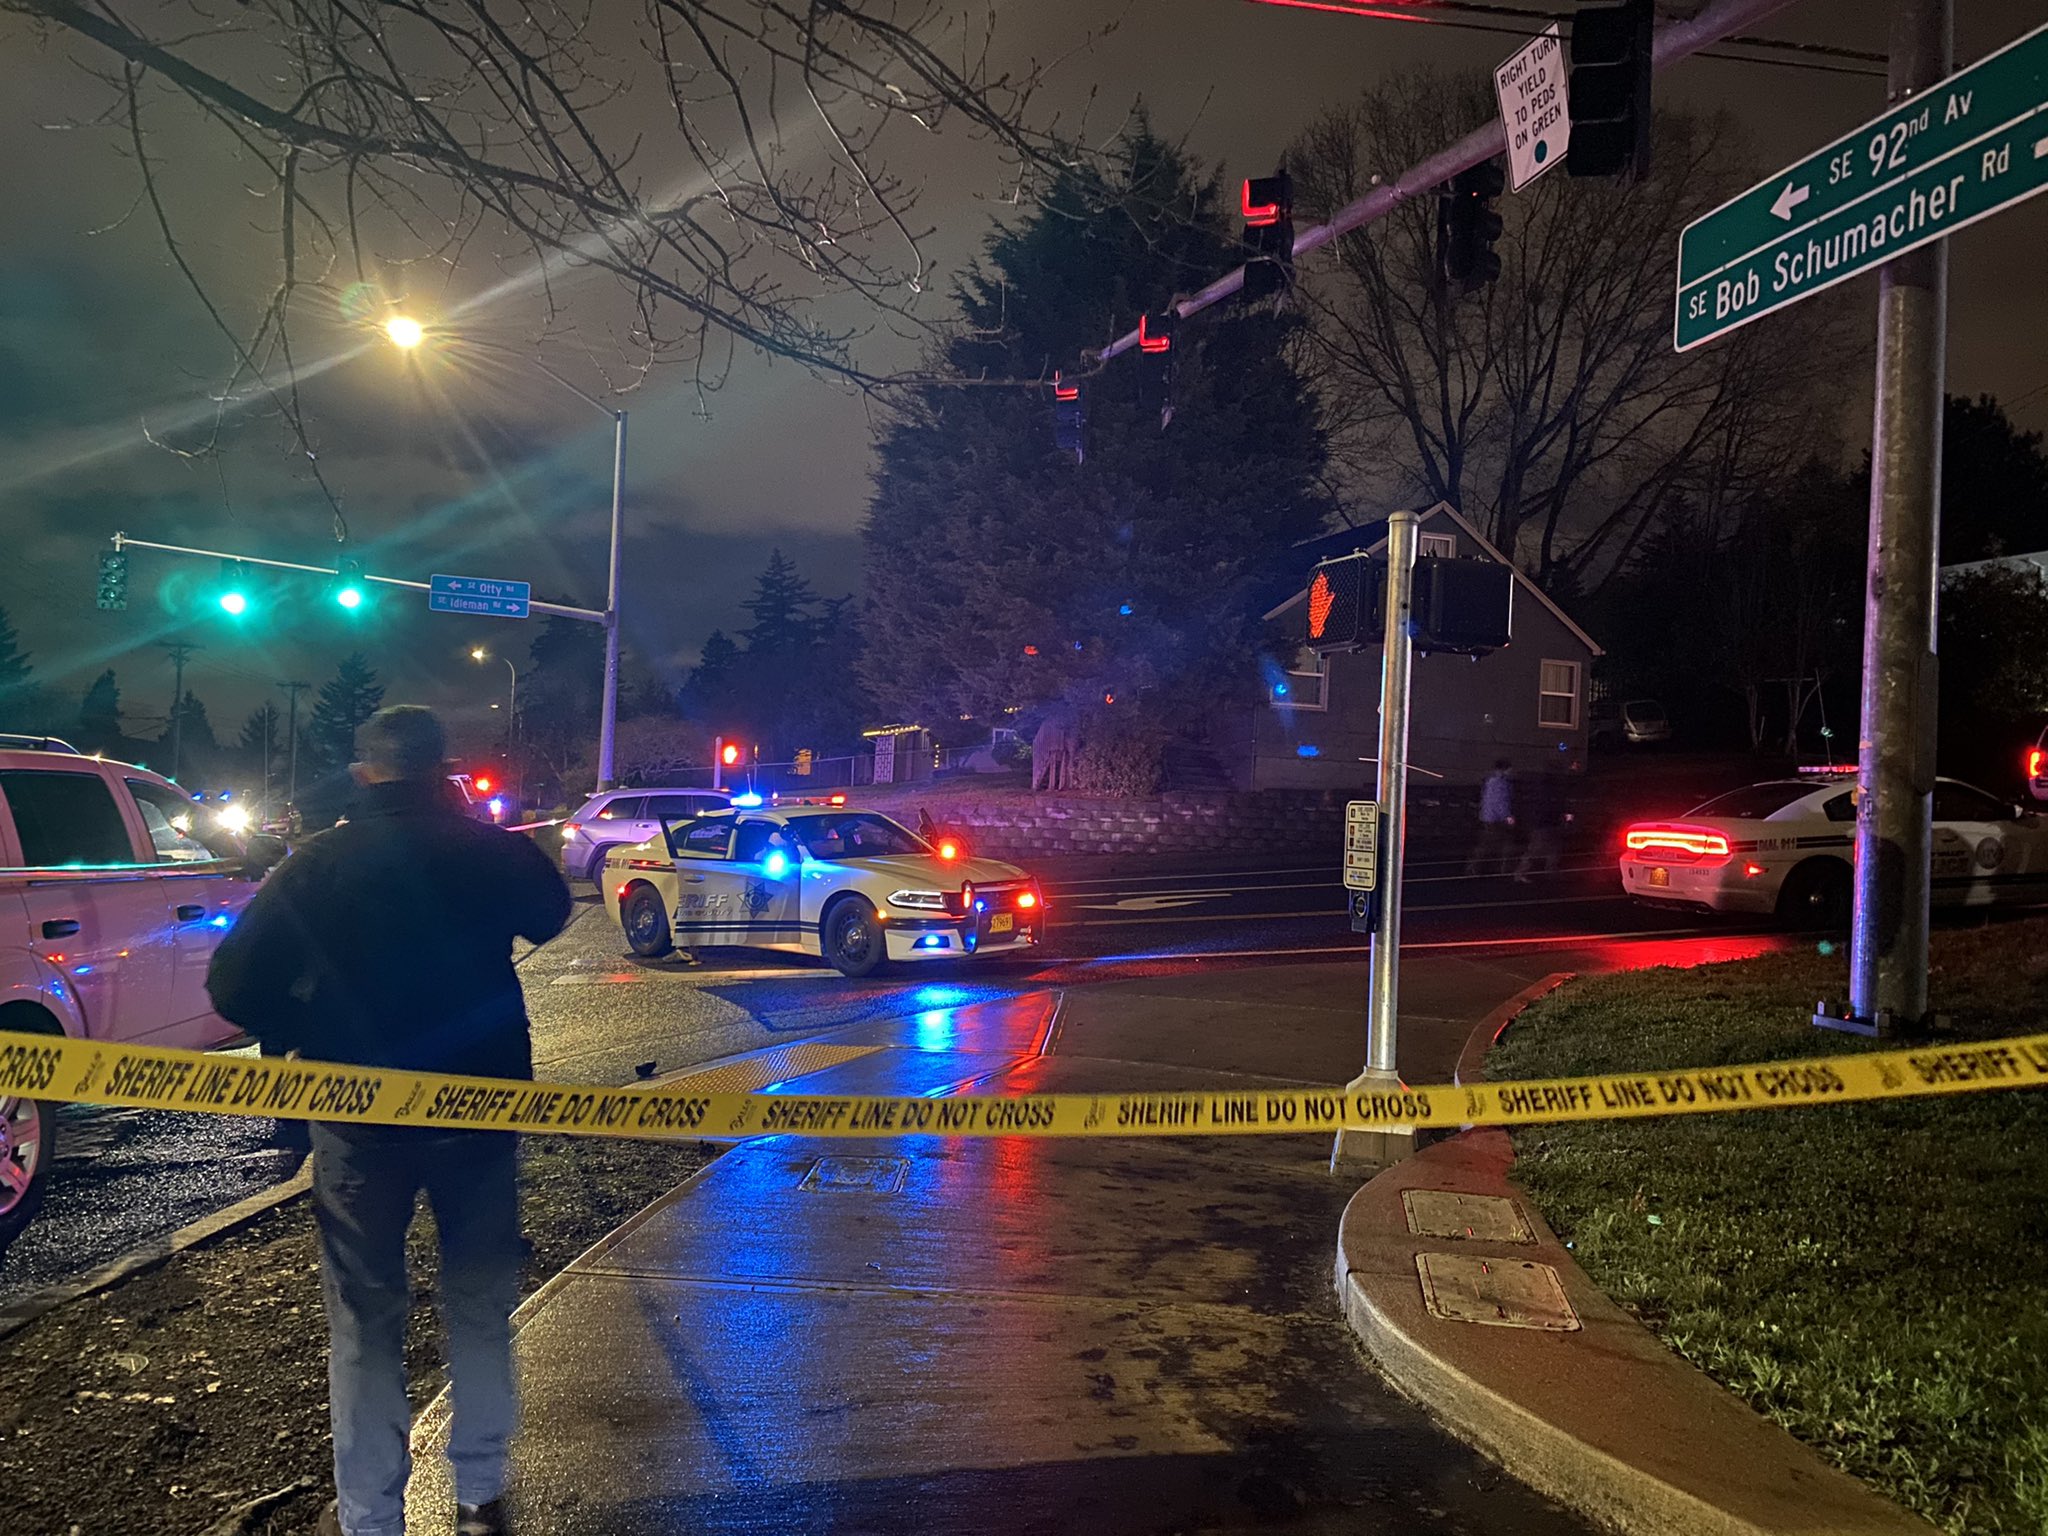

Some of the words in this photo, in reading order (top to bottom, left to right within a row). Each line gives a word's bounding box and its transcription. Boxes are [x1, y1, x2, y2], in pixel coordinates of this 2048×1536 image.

[1500, 57, 1527, 90] RIGHT
[1531, 36, 1558, 65] TURN
[1517, 67, 1546, 100] YIELD
[1515, 106, 1528, 126] TO
[1531, 83, 1556, 115] PEDS
[1515, 129, 1528, 150] ON
[1532, 102, 1562, 137] GREEN
[1829, 150, 1853, 185] SE
[1869, 108, 1929, 178] 92nd
[1944, 90, 1972, 125] Av
[1689, 290, 1707, 320] SE
[1716, 268, 1760, 320] Bob
[1773, 175, 1964, 292] Schumacher
[1981, 143, 2010, 181] Rd
[450, 598, 488, 611] Idleman
[480, 583, 502, 597] Otty
[105, 1056, 194, 1099] SHERIFF
[184, 1064, 240, 1105] LINE
[229, 1069, 270, 1108] DO
[262, 1073, 315, 1111] NOT
[308, 1074, 382, 1115] CROSS
[1908, 1047, 2021, 1084] SHERIFF
[426, 1084, 514, 1123] SHERIFF
[508, 1091, 563, 1124] LINE
[557, 1095, 596, 1127] DO
[590, 1097, 642, 1127] NOT
[637, 1098, 710, 1129] CROSS
[1117, 1098, 1202, 1126] SHERIFF
[1211, 1096, 1259, 1124] LINE
[1267, 1095, 1296, 1122] DO
[1305, 1094, 1348, 1121] NOT
[1357, 1092, 1431, 1119] CROSS
[1498, 1083, 1593, 1115] SHERIFF
[1600, 1079, 1656, 1109] LINE
[1659, 1076, 1695, 1103] DO
[1700, 1072, 1750, 1100] NOT
[1755, 1063, 1845, 1096] CROSS
[761, 1100, 850, 1129] SHERIFF
[850, 1100, 900, 1129] LINE
[900, 1101, 932, 1129] DO
[937, 1101, 982, 1129] NOT
[986, 1101, 1055, 1127] CROSS
